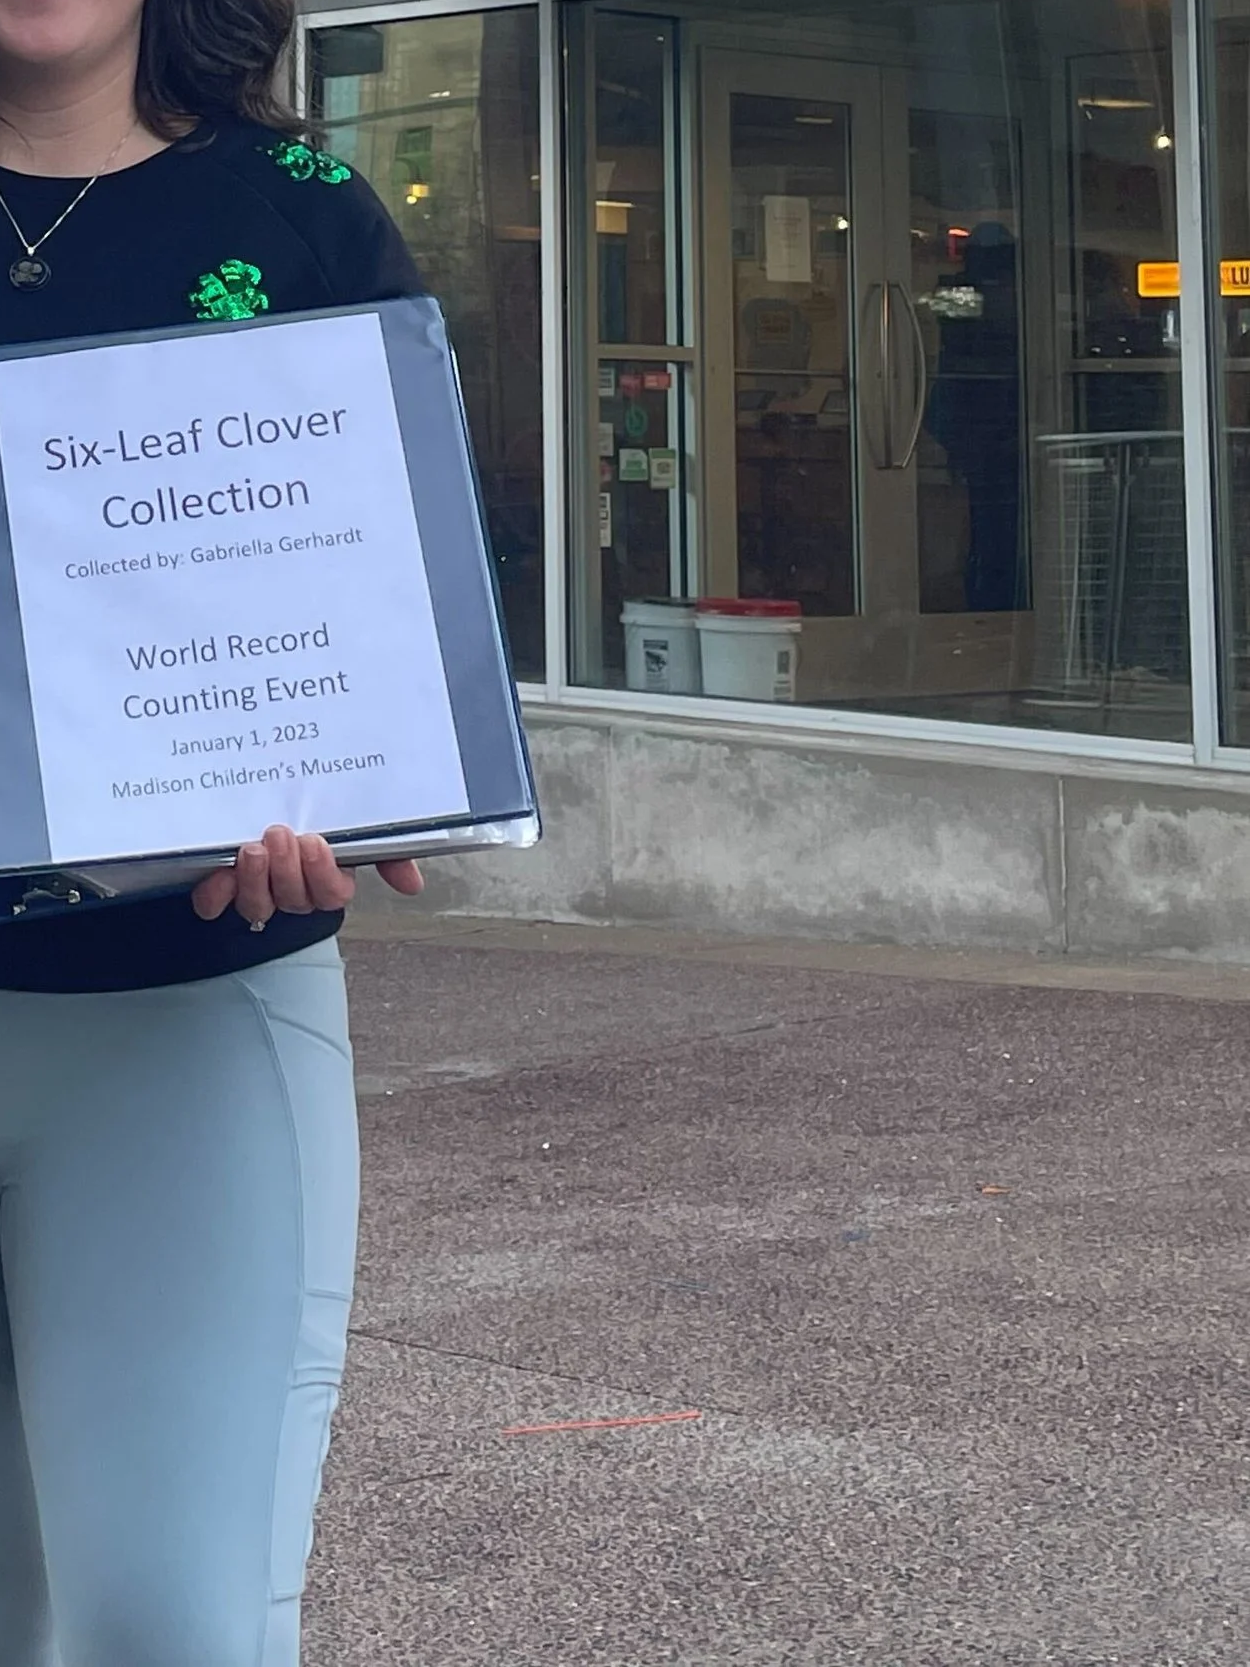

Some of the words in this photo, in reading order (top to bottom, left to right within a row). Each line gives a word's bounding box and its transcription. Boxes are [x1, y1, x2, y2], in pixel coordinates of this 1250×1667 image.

[44, 419, 203, 470] Six-Leaf
[217, 408, 347, 448] Clover
[102, 479, 310, 529] Collection
[65, 553, 152, 579] Collected
[156, 549, 184, 570] by:
[190, 539, 273, 564] Gabriella
[278, 527, 363, 552] Gerhardt
[125, 636, 218, 671] World
[227, 622, 330, 659] Record
[123, 684, 258, 720] Counting
[266, 671, 350, 702] Event
[171, 734, 244, 756] January
[249, 730, 268, 749] 1,
[273, 722, 320, 743] 2023
[112, 777, 195, 799] Madison
[200, 761, 296, 789] Children's
[301, 752, 386, 777] Museum
